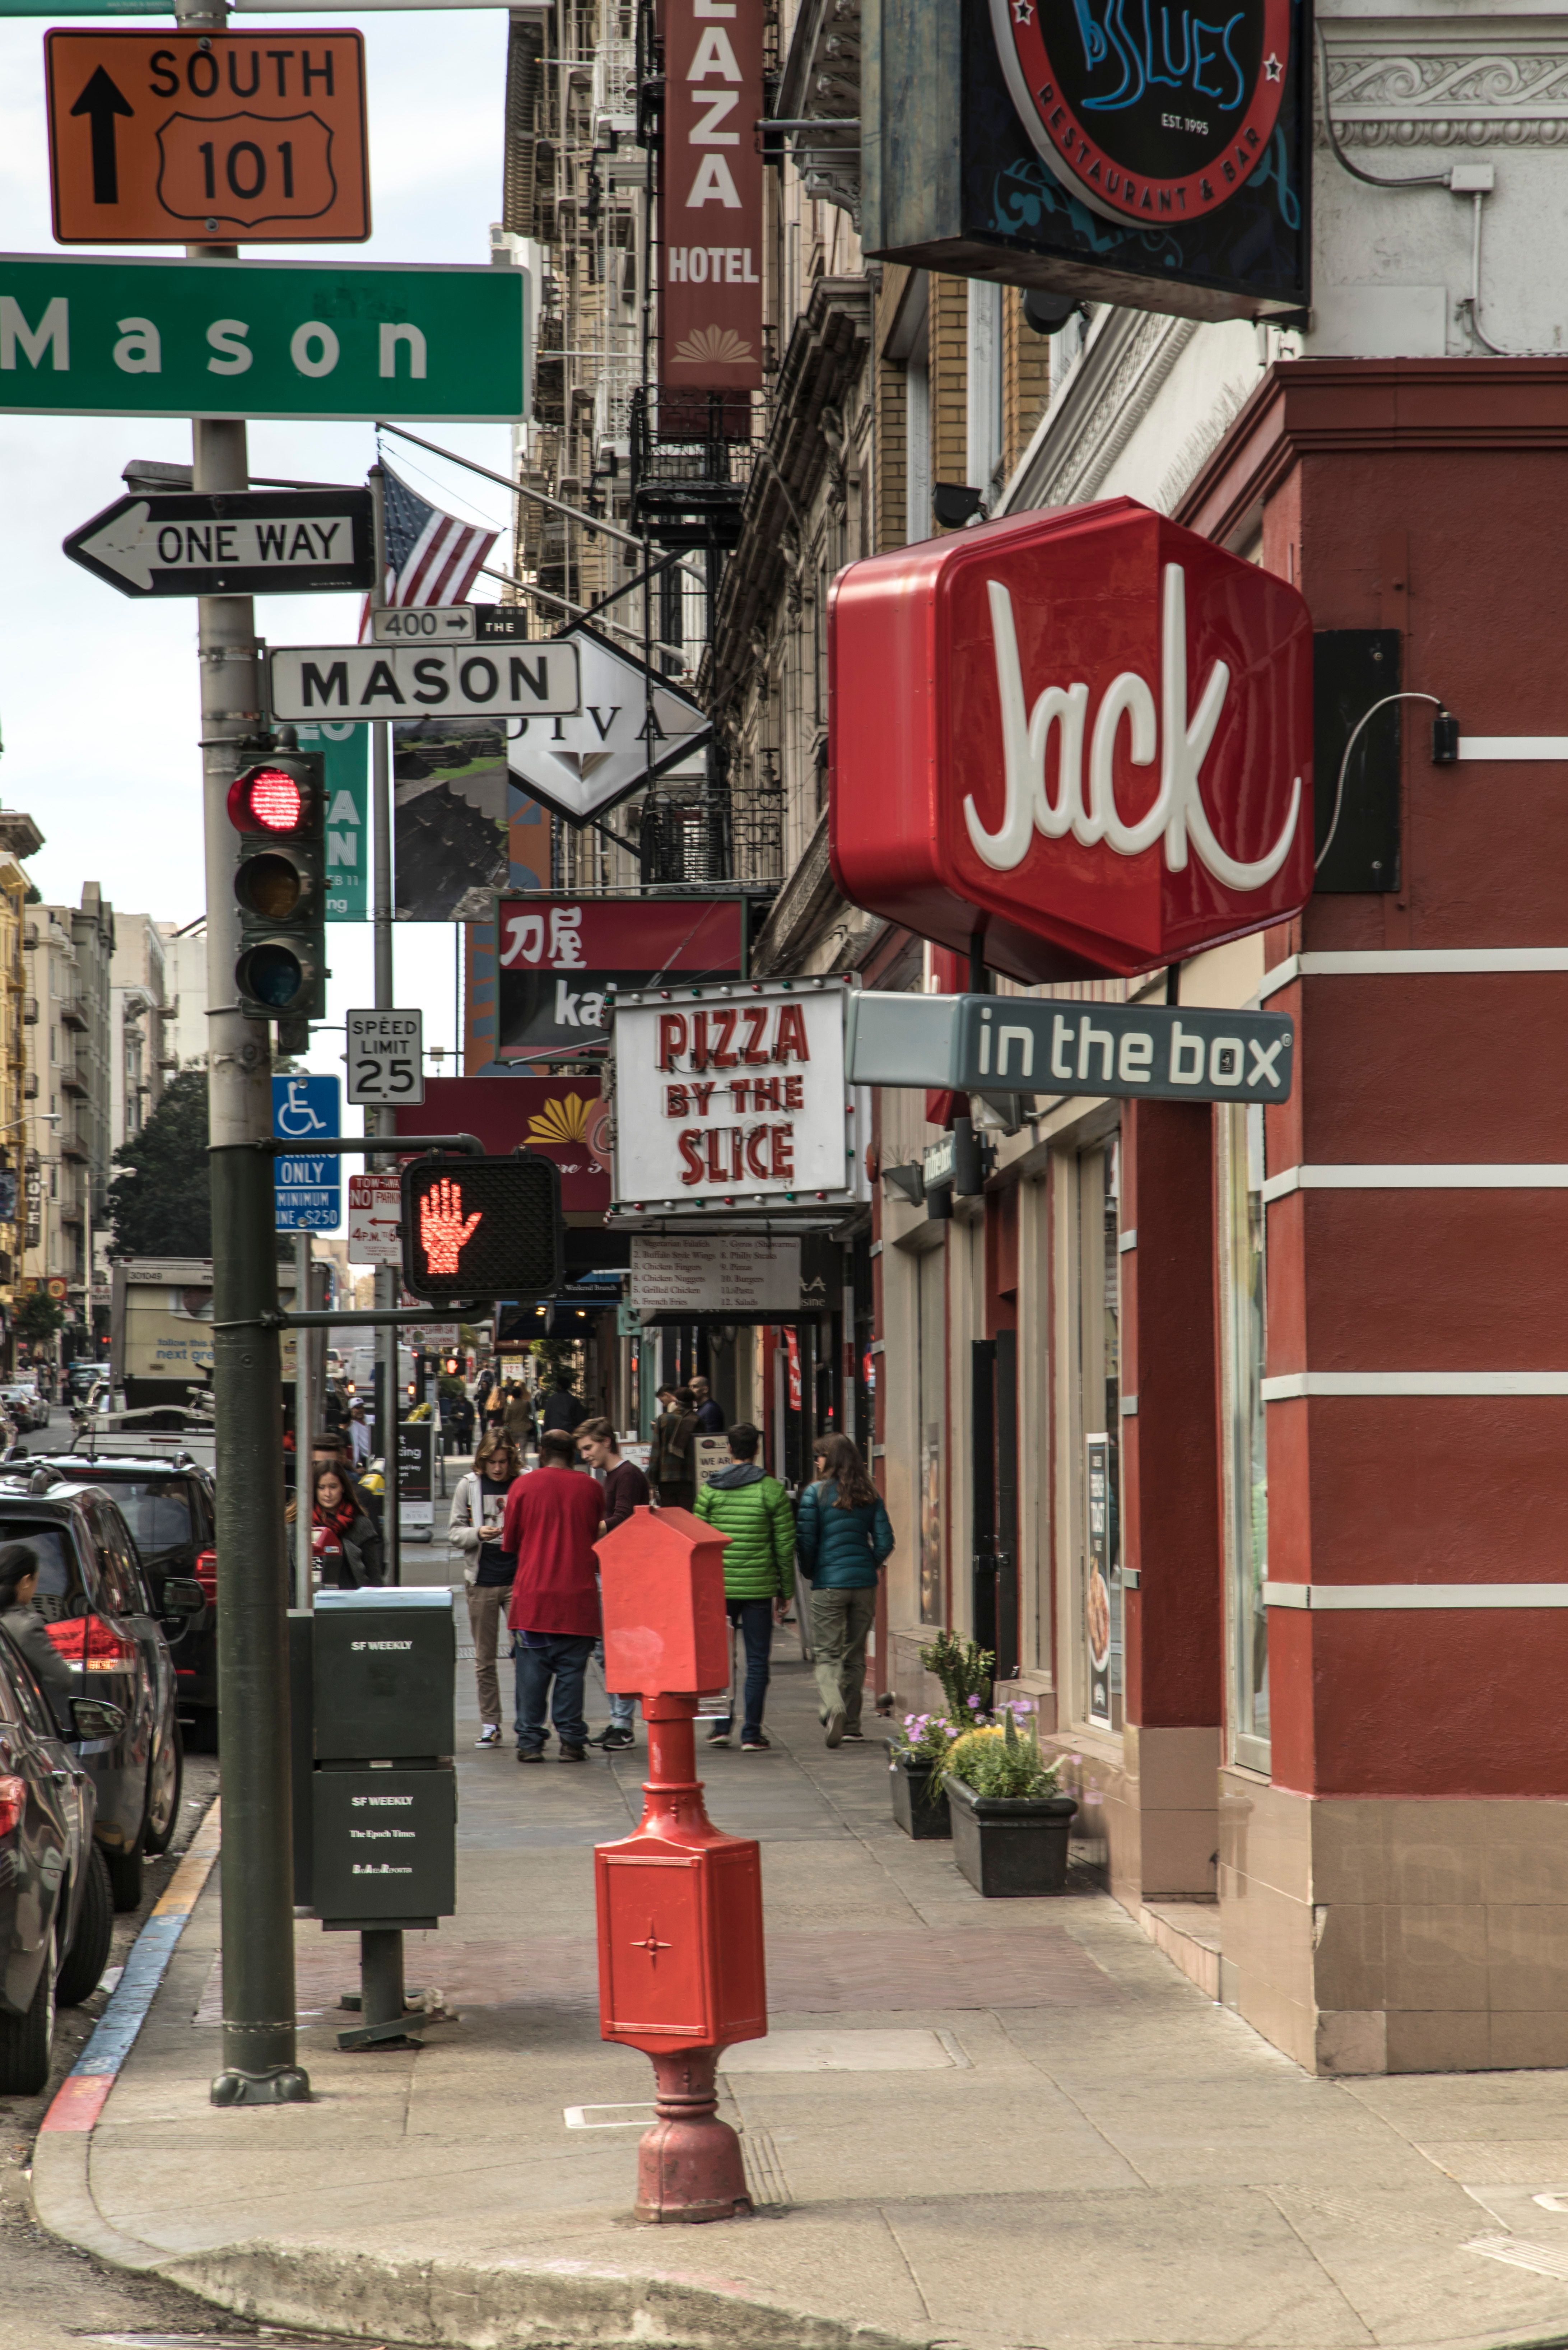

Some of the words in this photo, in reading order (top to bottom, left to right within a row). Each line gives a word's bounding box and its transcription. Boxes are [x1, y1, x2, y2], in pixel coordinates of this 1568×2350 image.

[149, 50, 335, 98] SOUTH
[1162, 113, 1183, 130] EST.
[1185, 118, 1209, 135] 1995
[1038, 83, 1186, 212] RESTAURANT
[1221, 126, 1260, 182] BAR
[199, 141, 294, 199] 101
[669, 247, 759, 283] HOTEL
[0, 296, 427, 379] Mason
[158, 526, 239, 563] ONE
[256, 523, 340, 560] WAY
[385, 613, 437, 636] 400
[485, 622, 514, 632] THE
[301, 656, 548, 706] MASON
[963, 563, 1302, 891] Jack
[499, 906, 587, 968] 刀屋
[352, 1020, 417, 1035] SPEED
[655, 1004, 810, 1073] PIZZA
[360, 1040, 410, 1054] LIMIT
[978, 1008, 1034, 1077] in
[1051, 1015, 1154, 1082] the
[1169, 1021, 1282, 1088] box
[355, 1059, 415, 1093] 25
[663, 1081, 717, 1118] BY
[726, 1075, 805, 1114] THE
[678, 1120, 795, 1186] SLICE
[281, 1162, 325, 1184] ONLY
[355, 1178, 401, 1188] TOW-AWA
[276, 1192, 329, 1206] MINIMUM
[349, 1189, 372, 1206] NO
[376, 1191, 401, 1204] PARKIN
[304, 1209, 338, 1225] $250
[156, 1349, 187, 1360] next
[191, 1351, 215, 1362] gre
[351, 1642, 367, 1651] SF
[367, 1641, 413, 1650] WEEKLY
[351, 1797, 367, 1806] SF
[368, 1796, 413, 1806] WEEKLY
[366, 1830, 391, 1839] Epoch
[381, 1864, 413, 1874] REPORTER
